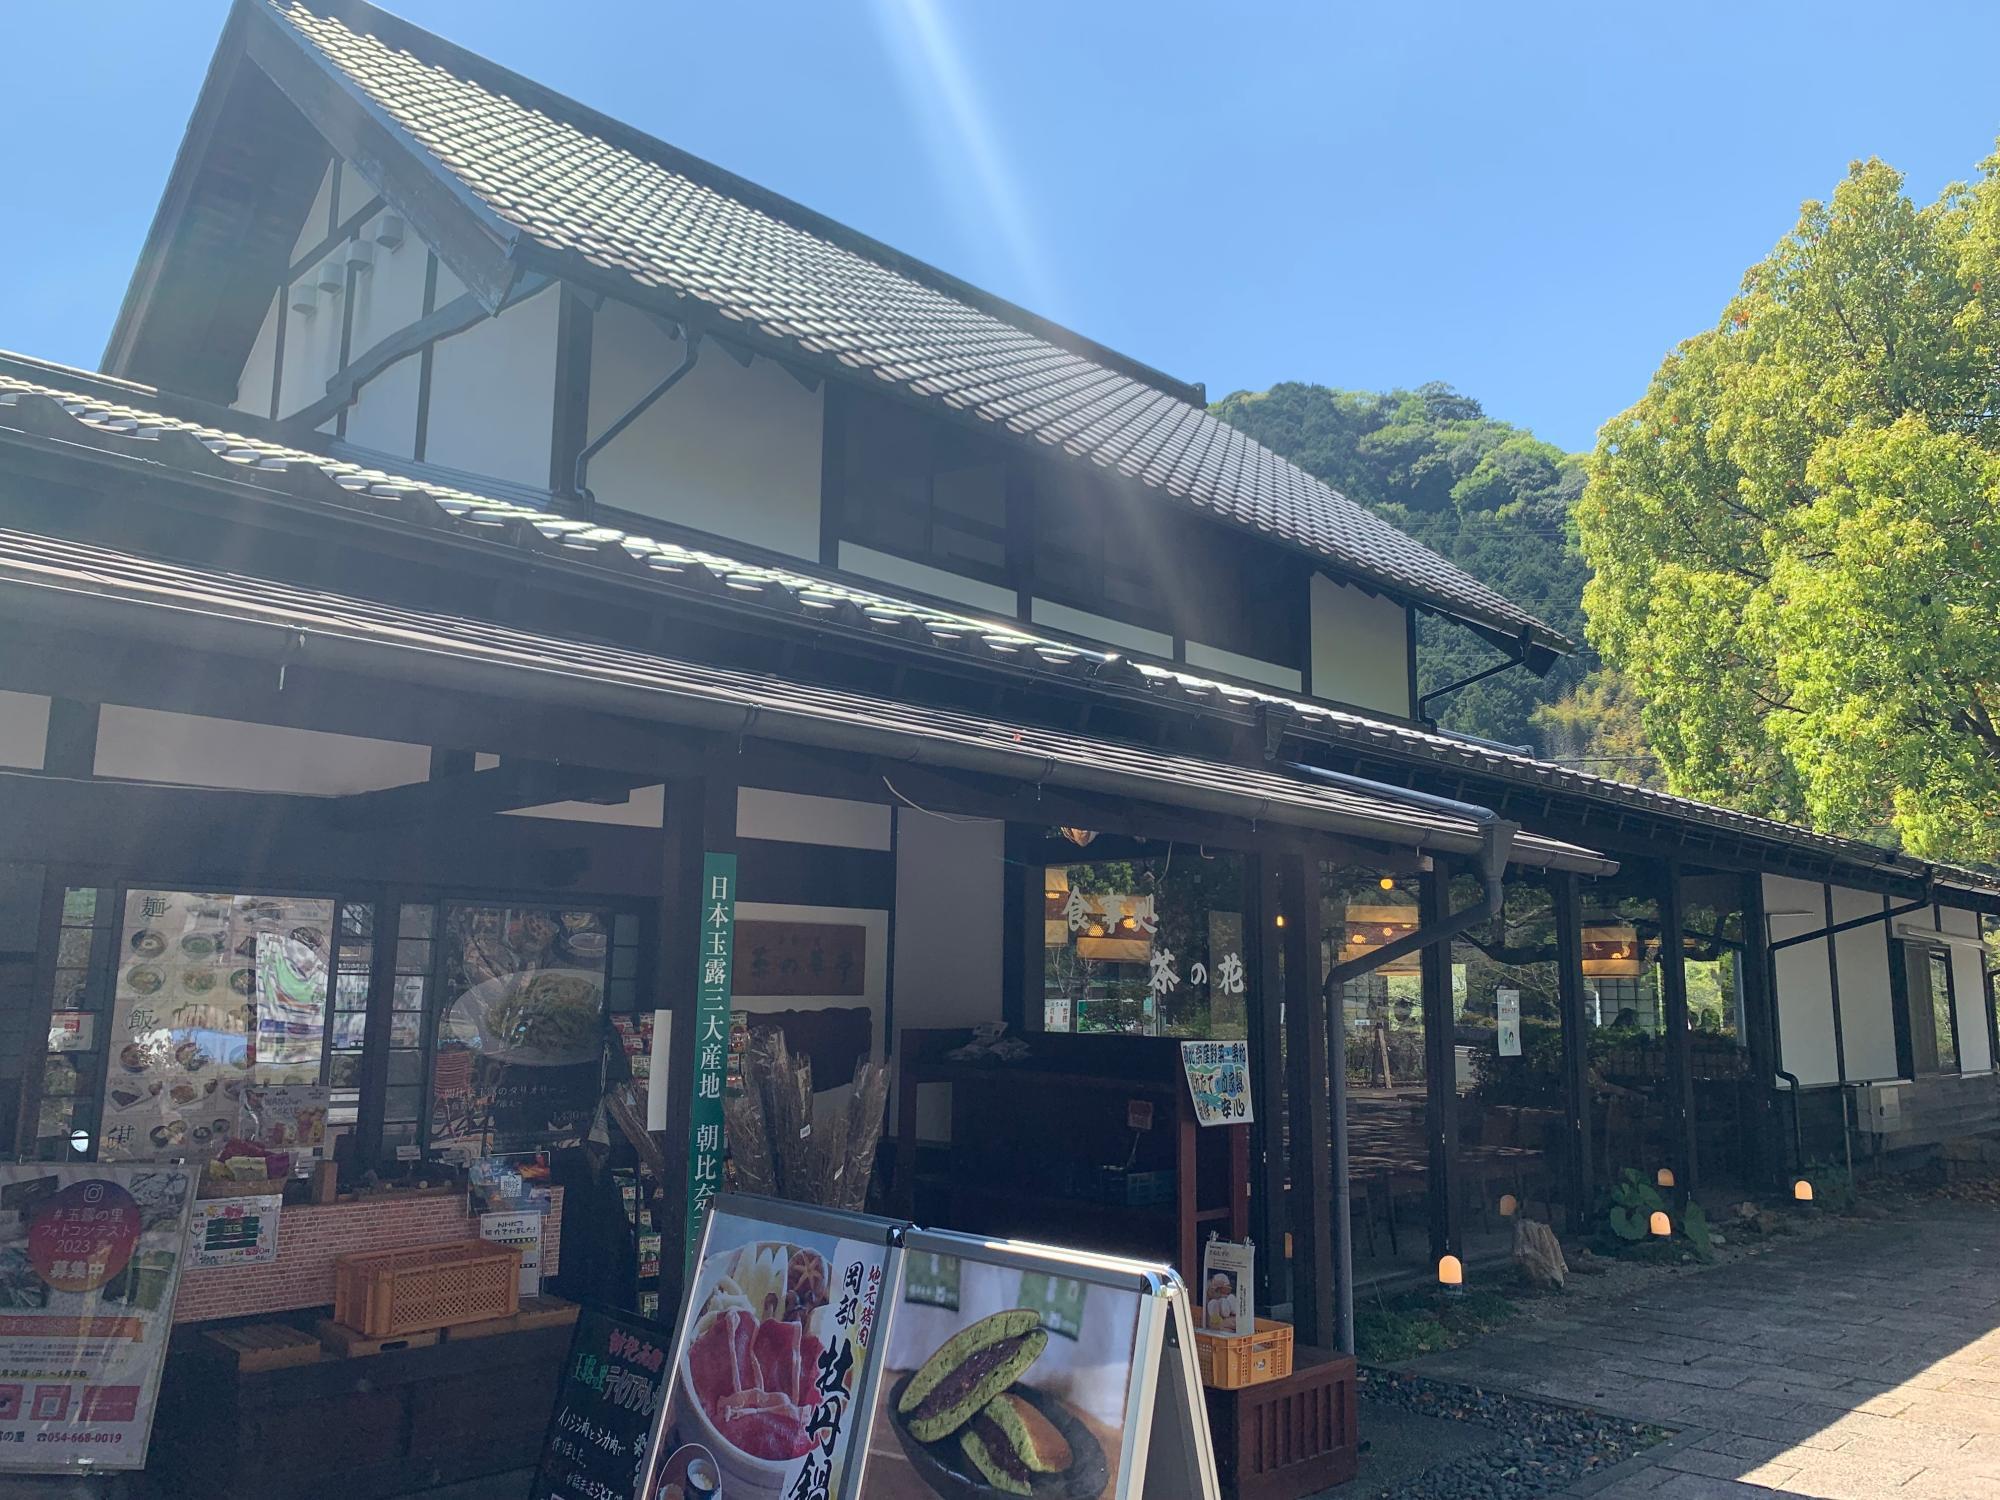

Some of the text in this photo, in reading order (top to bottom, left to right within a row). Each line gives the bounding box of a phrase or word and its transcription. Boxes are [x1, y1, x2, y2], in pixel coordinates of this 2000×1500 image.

[698, 875, 729, 1100] 日本玉露三大産地
[1148, 948, 1245, 995] 茶の花
[40, 1224, 131, 1237] フォトコンテスト
[56, 1239, 91, 1253] 2023
[50, 1260, 105, 1279] 募集中
[835, 1260, 865, 1330] 岡部
[855, 1265, 882, 1348] 地元猪肉
[47, 1431, 122, 1443] 054-668-0019
